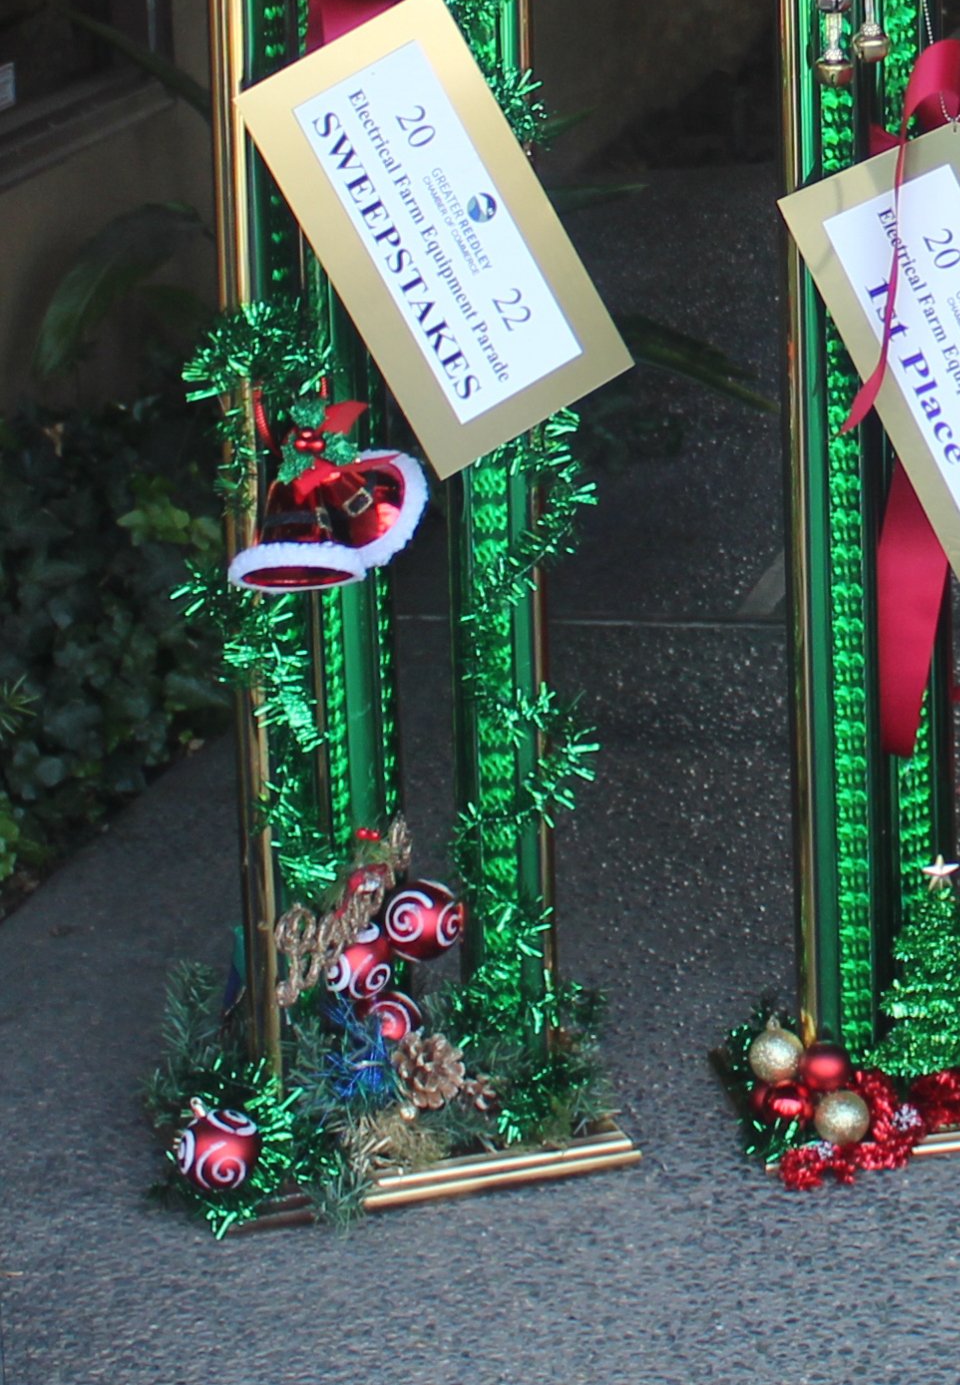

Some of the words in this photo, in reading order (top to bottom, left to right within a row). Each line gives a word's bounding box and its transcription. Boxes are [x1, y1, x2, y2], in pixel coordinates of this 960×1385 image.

[311, 111, 482, 400] SWEEPSTAKES
[347, 88, 402, 174] Electrical
[393, 173, 425, 225] Farm
[420, 223, 479, 320] Equipment
[471, 320, 510, 383] Parade
[395, 104, 436, 148] 20
[491, 287, 531, 332] 22
[431, 167, 465, 220] GREATER
[458, 218, 493, 271] REEDLEY
[917, 292, 948, 344] Farm
